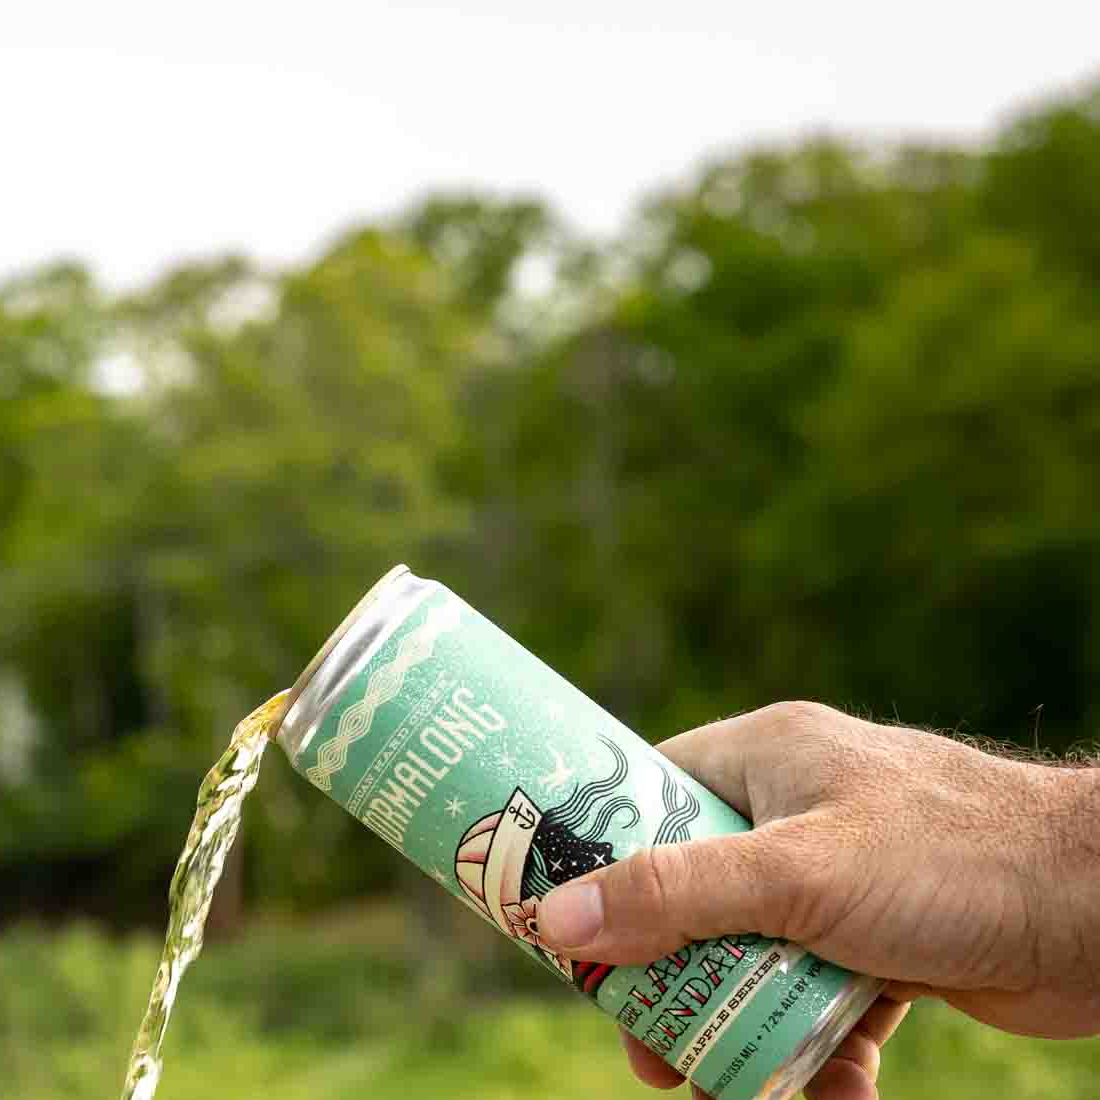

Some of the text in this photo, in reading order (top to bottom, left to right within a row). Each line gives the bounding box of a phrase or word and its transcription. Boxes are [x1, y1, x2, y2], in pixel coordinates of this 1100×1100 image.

[628, 941, 706, 1011] LAD
[762, 1007, 786, 1033] 7.2%
[783, 989, 800, 1012] ALC
[677, 1053, 696, 1076] ARE
[693, 1009, 730, 1055] APPLE
[729, 951, 781, 1010] SERIES
